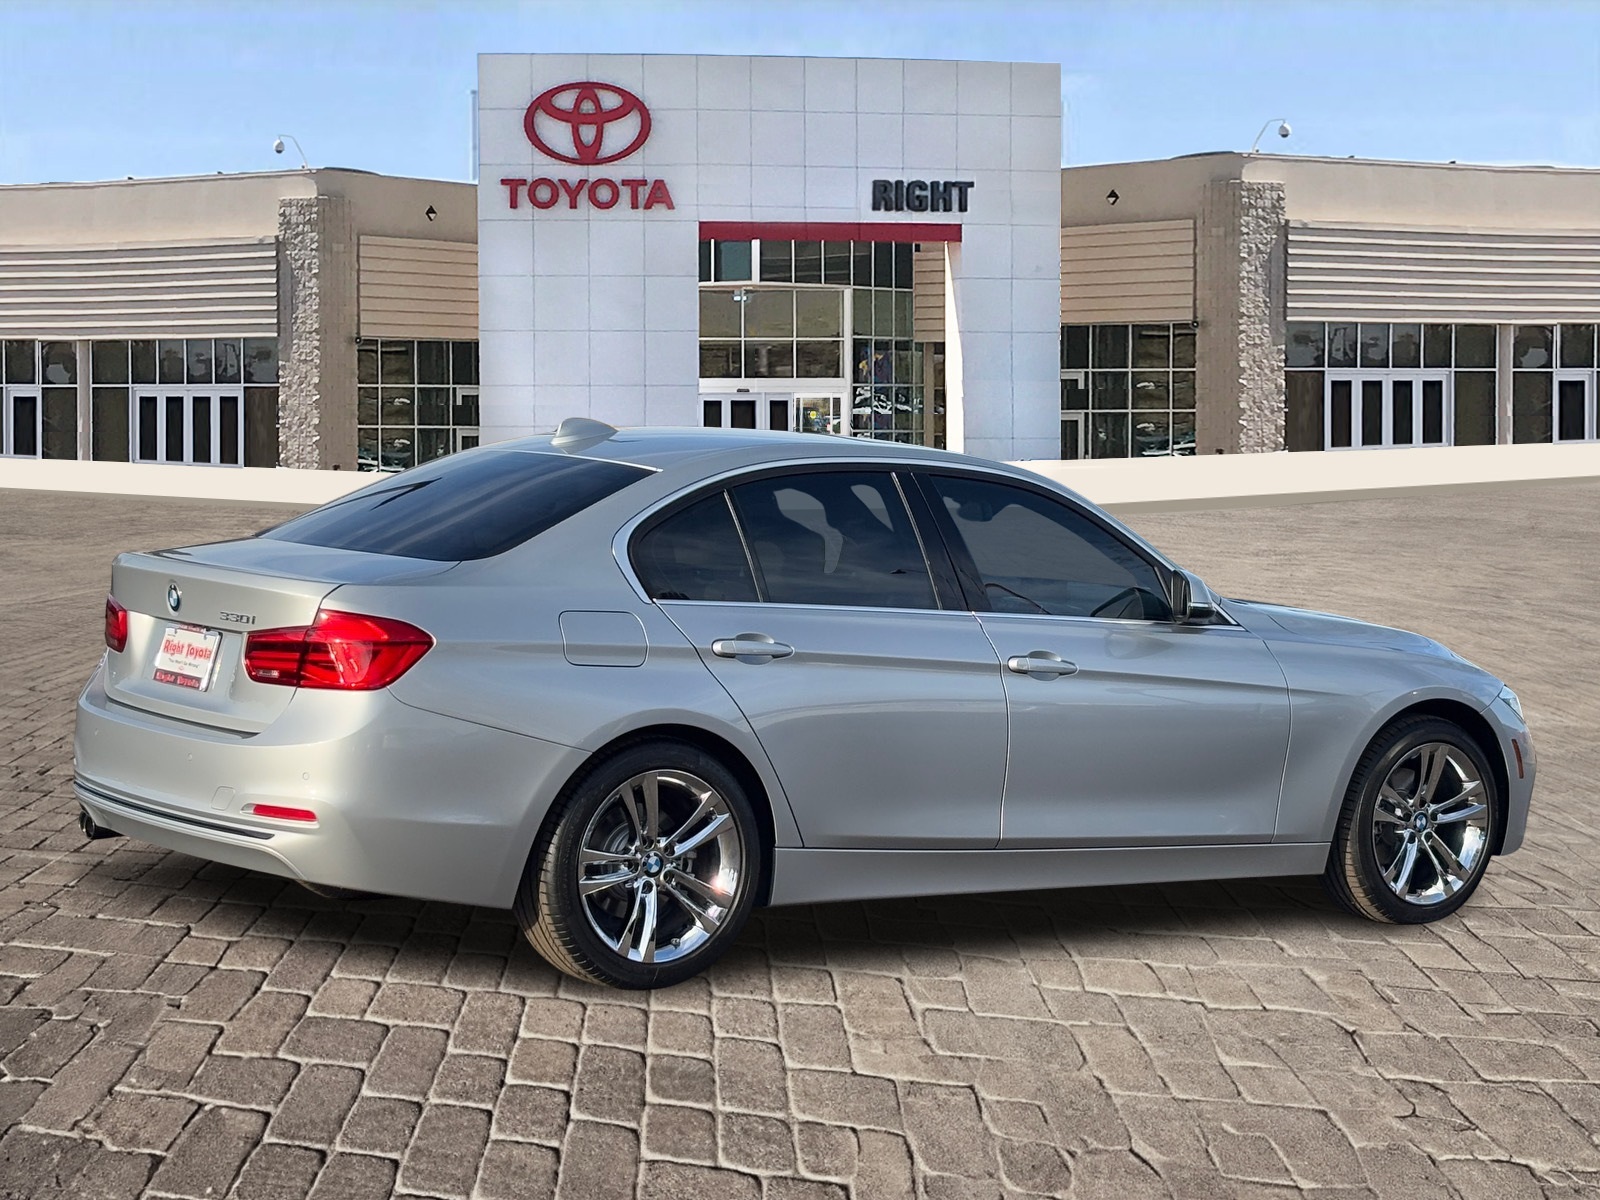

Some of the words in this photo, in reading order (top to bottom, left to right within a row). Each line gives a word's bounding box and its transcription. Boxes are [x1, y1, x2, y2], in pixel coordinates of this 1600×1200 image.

[501, 178, 675, 209] TOYOTA
[872, 180, 974, 212] RIGHT
[220, 612, 256, 625] 330i
[163, 640, 184, 656] Right
[186, 644, 212, 659] Toyota
